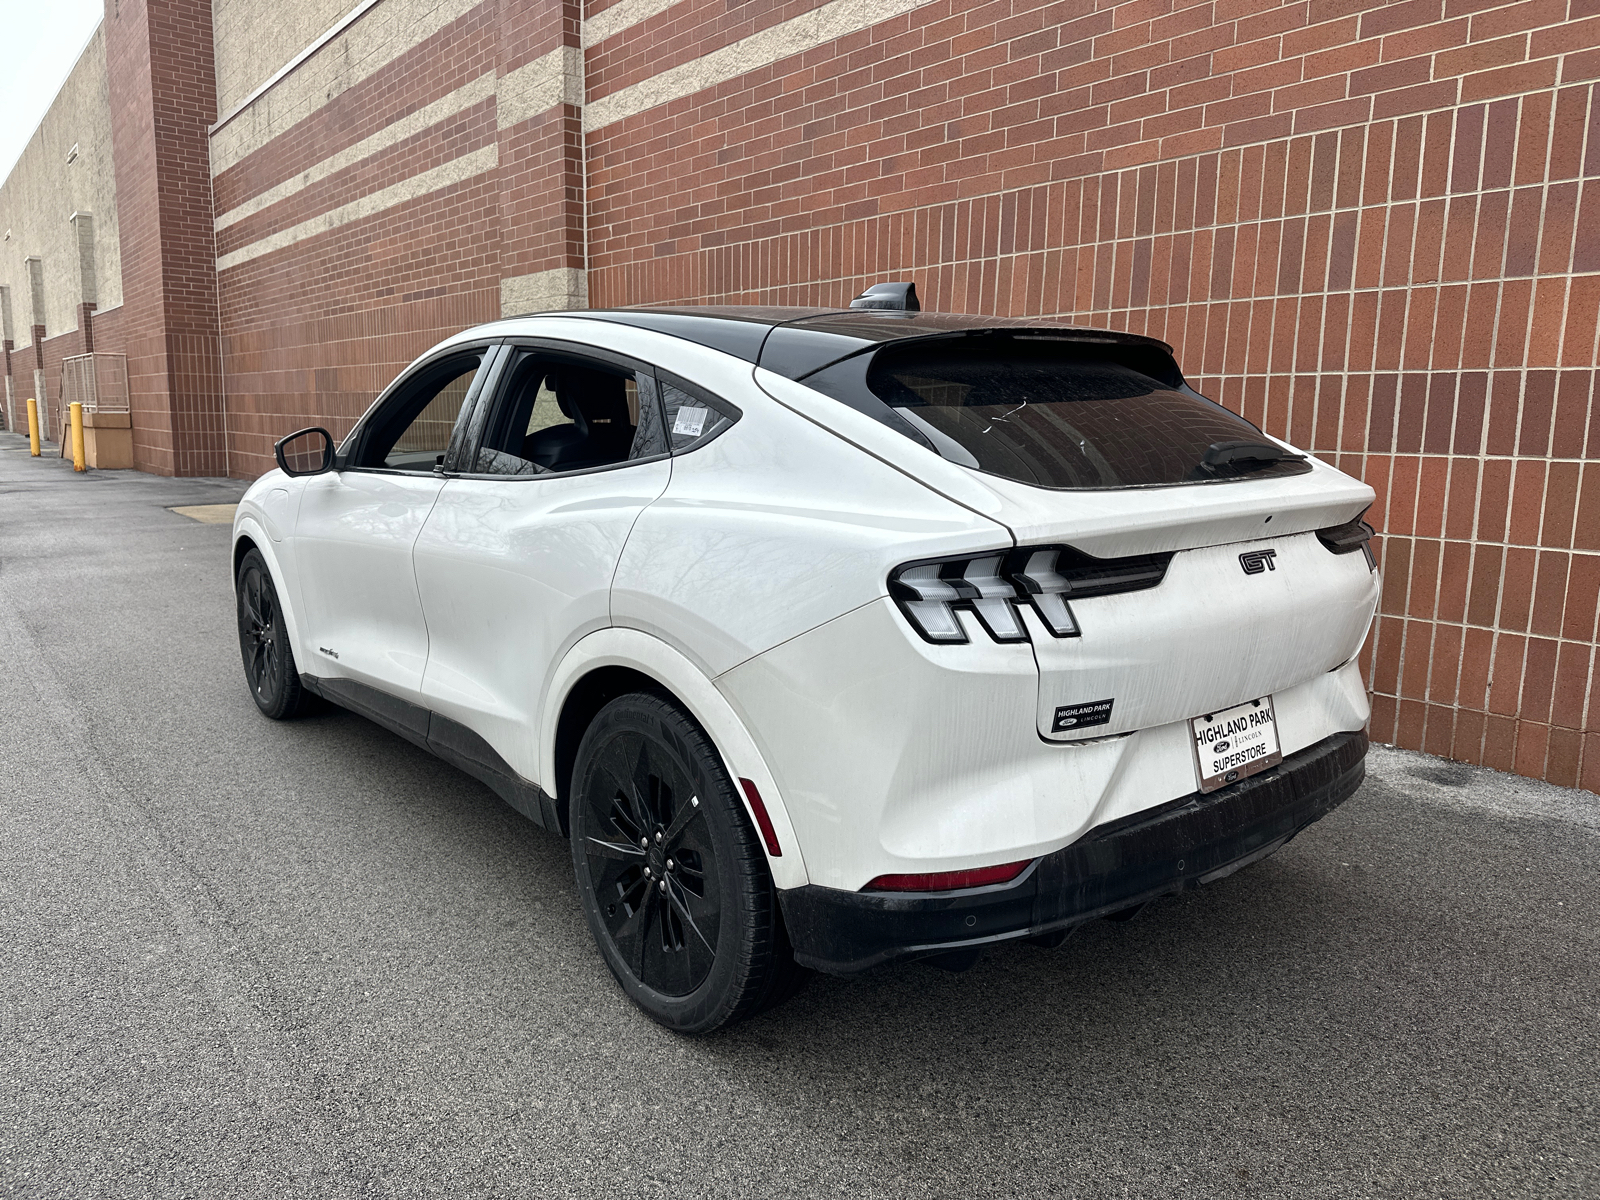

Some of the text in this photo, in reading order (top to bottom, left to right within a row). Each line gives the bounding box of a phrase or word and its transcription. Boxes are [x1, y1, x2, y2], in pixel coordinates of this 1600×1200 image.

[1238, 549, 1277, 575] GT
[614, 708, 650, 724] Continental
[1058, 703, 1111, 718] HIGHLAND PARK
[1081, 714, 1106, 722] LINCOLN
[1195, 708, 1273, 746] HIGHLAND PARK
[1215, 730, 1262, 753] Ford LINCOLN
[1213, 742, 1267, 773] SUPERSTORE
